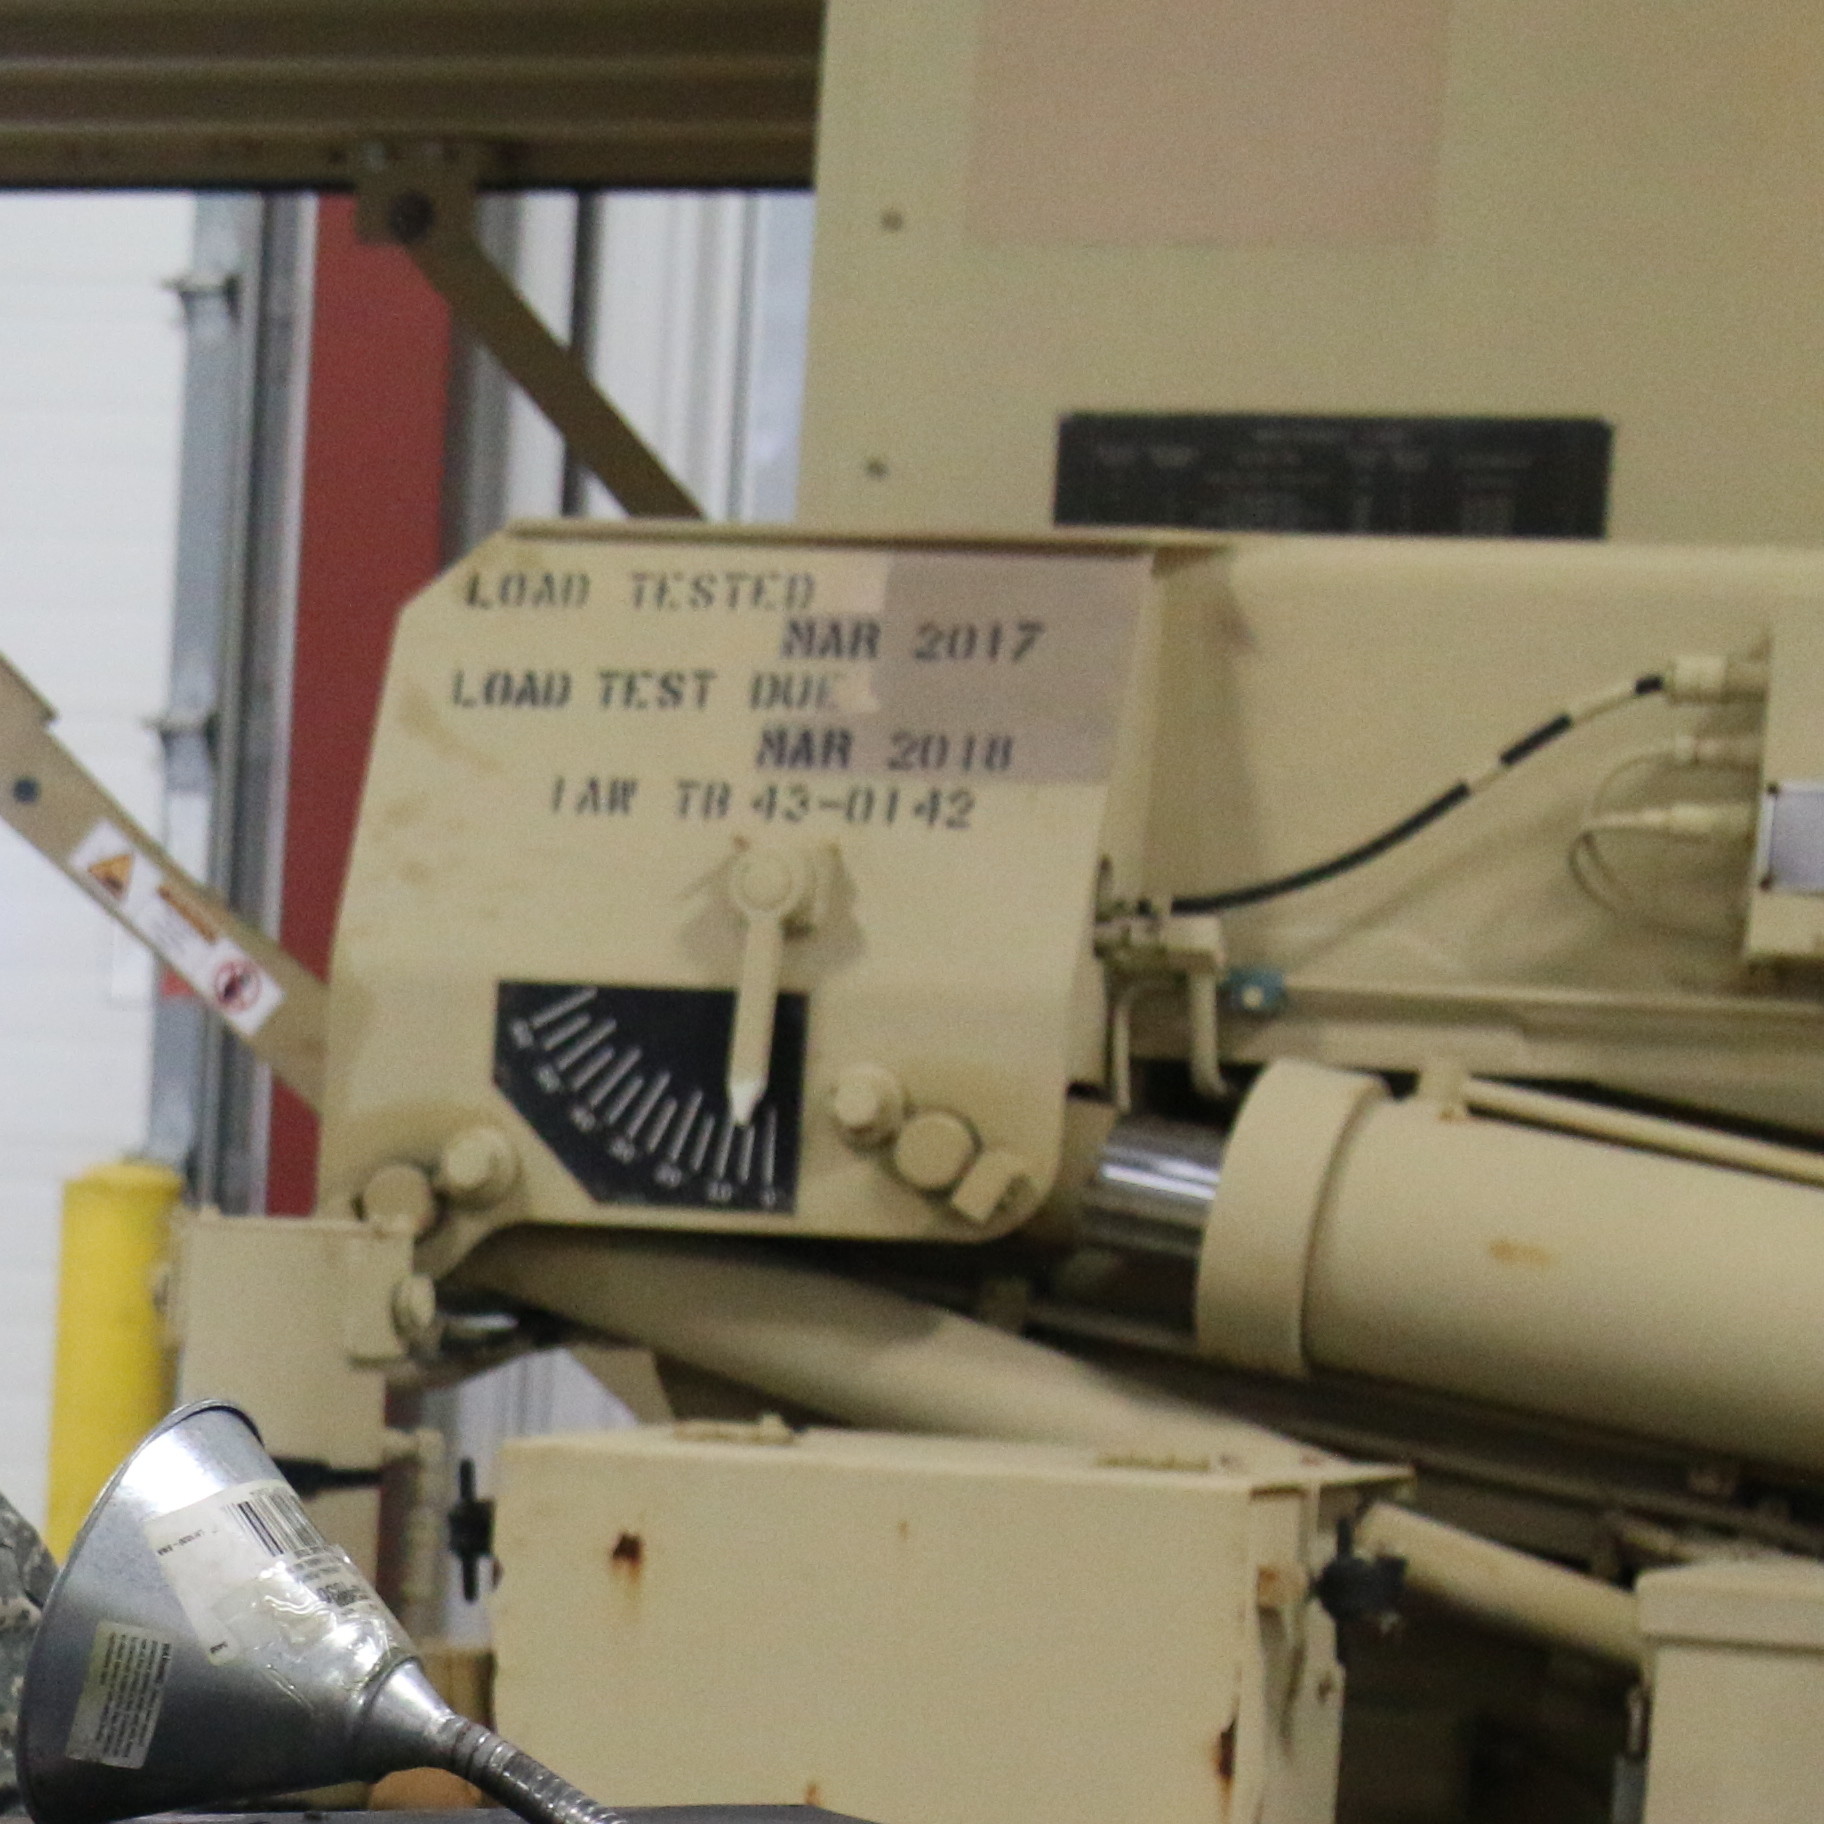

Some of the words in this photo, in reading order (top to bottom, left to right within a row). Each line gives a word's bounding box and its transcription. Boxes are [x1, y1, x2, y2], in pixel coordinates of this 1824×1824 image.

[466, 571, 592, 611] LOAD
[630, 570, 816, 611] TESTED
[780, 619, 882, 660] MAR
[914, 621, 1045, 663] 2017
[451, 668, 573, 710] LOAD
[596, 668, 717, 710] TEST
[756, 727, 855, 770] MAR
[887, 730, 1015, 773] 2018
